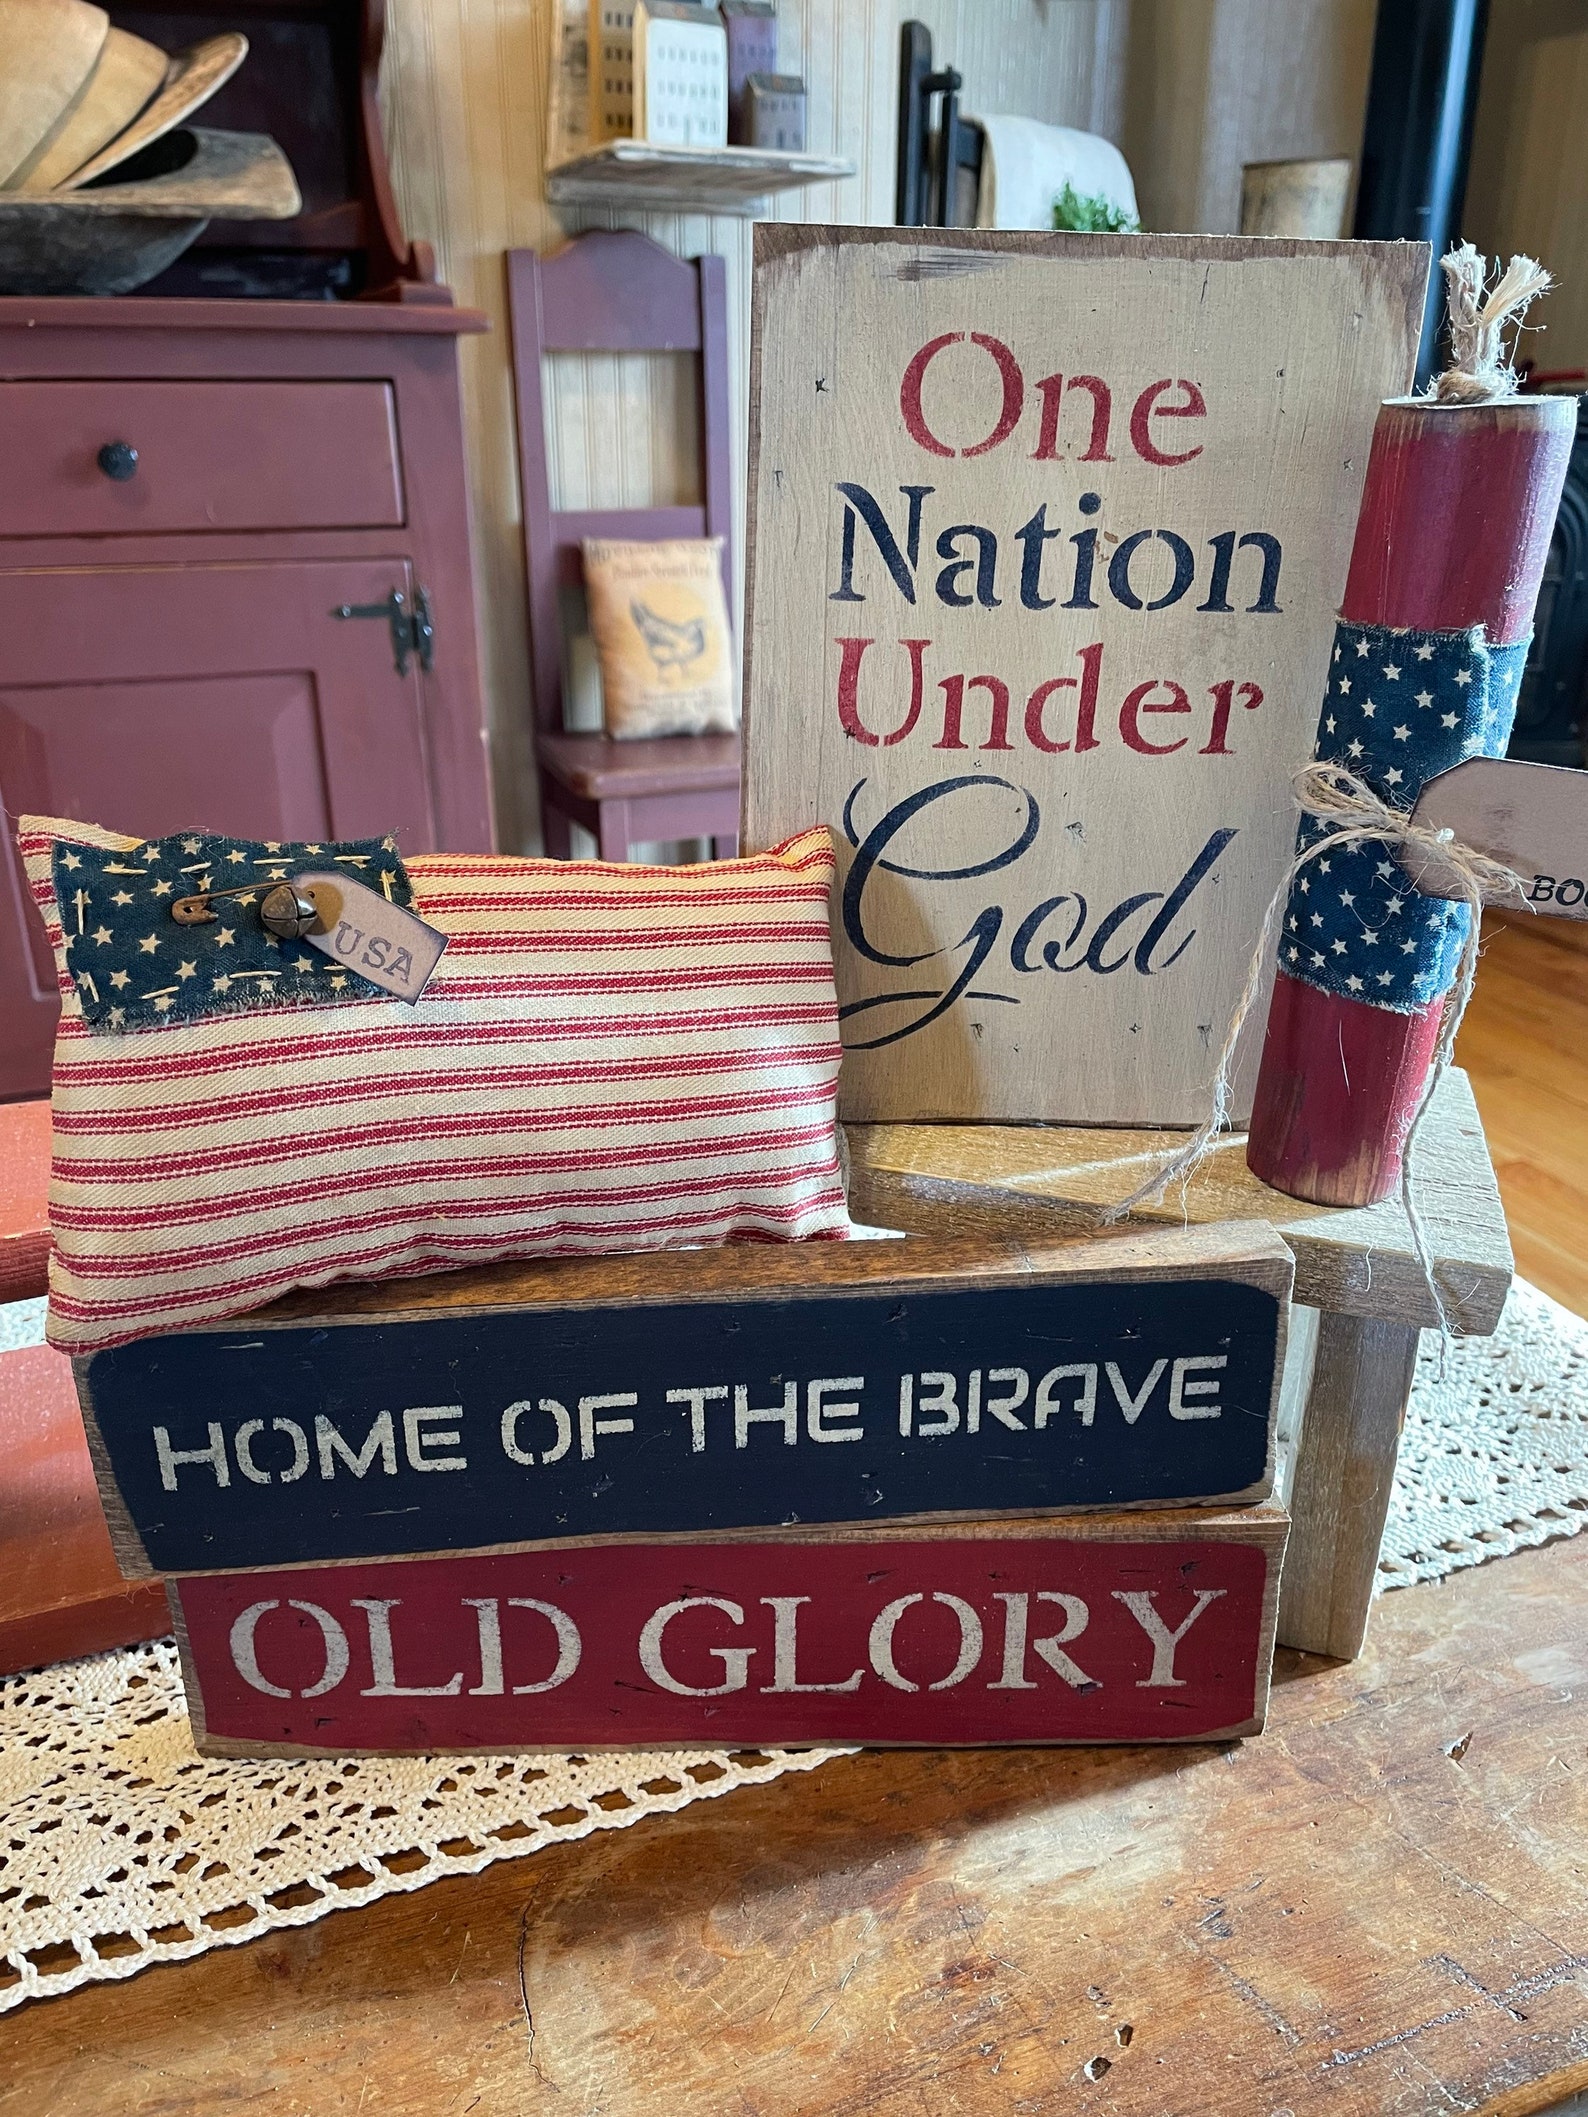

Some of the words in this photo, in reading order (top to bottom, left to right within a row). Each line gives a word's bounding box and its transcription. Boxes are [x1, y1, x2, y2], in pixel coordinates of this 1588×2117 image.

[901, 332, 1205, 466] One
[829, 482, 1284, 613] Nation
[833, 637, 1264, 755] Under
[334, 920, 414, 984] USA
[841, 775, 1239, 1050] God
[1525, 874, 1588, 907] BO
[152, 1405, 468, 1492] HOME
[500, 1391, 638, 1466] OF
[665, 1376, 865, 1453] THE
[899, 1355, 1228, 1438] BRAVE
[229, 1597, 582, 1699] OLD
[638, 1589, 1228, 1698] GLORY
